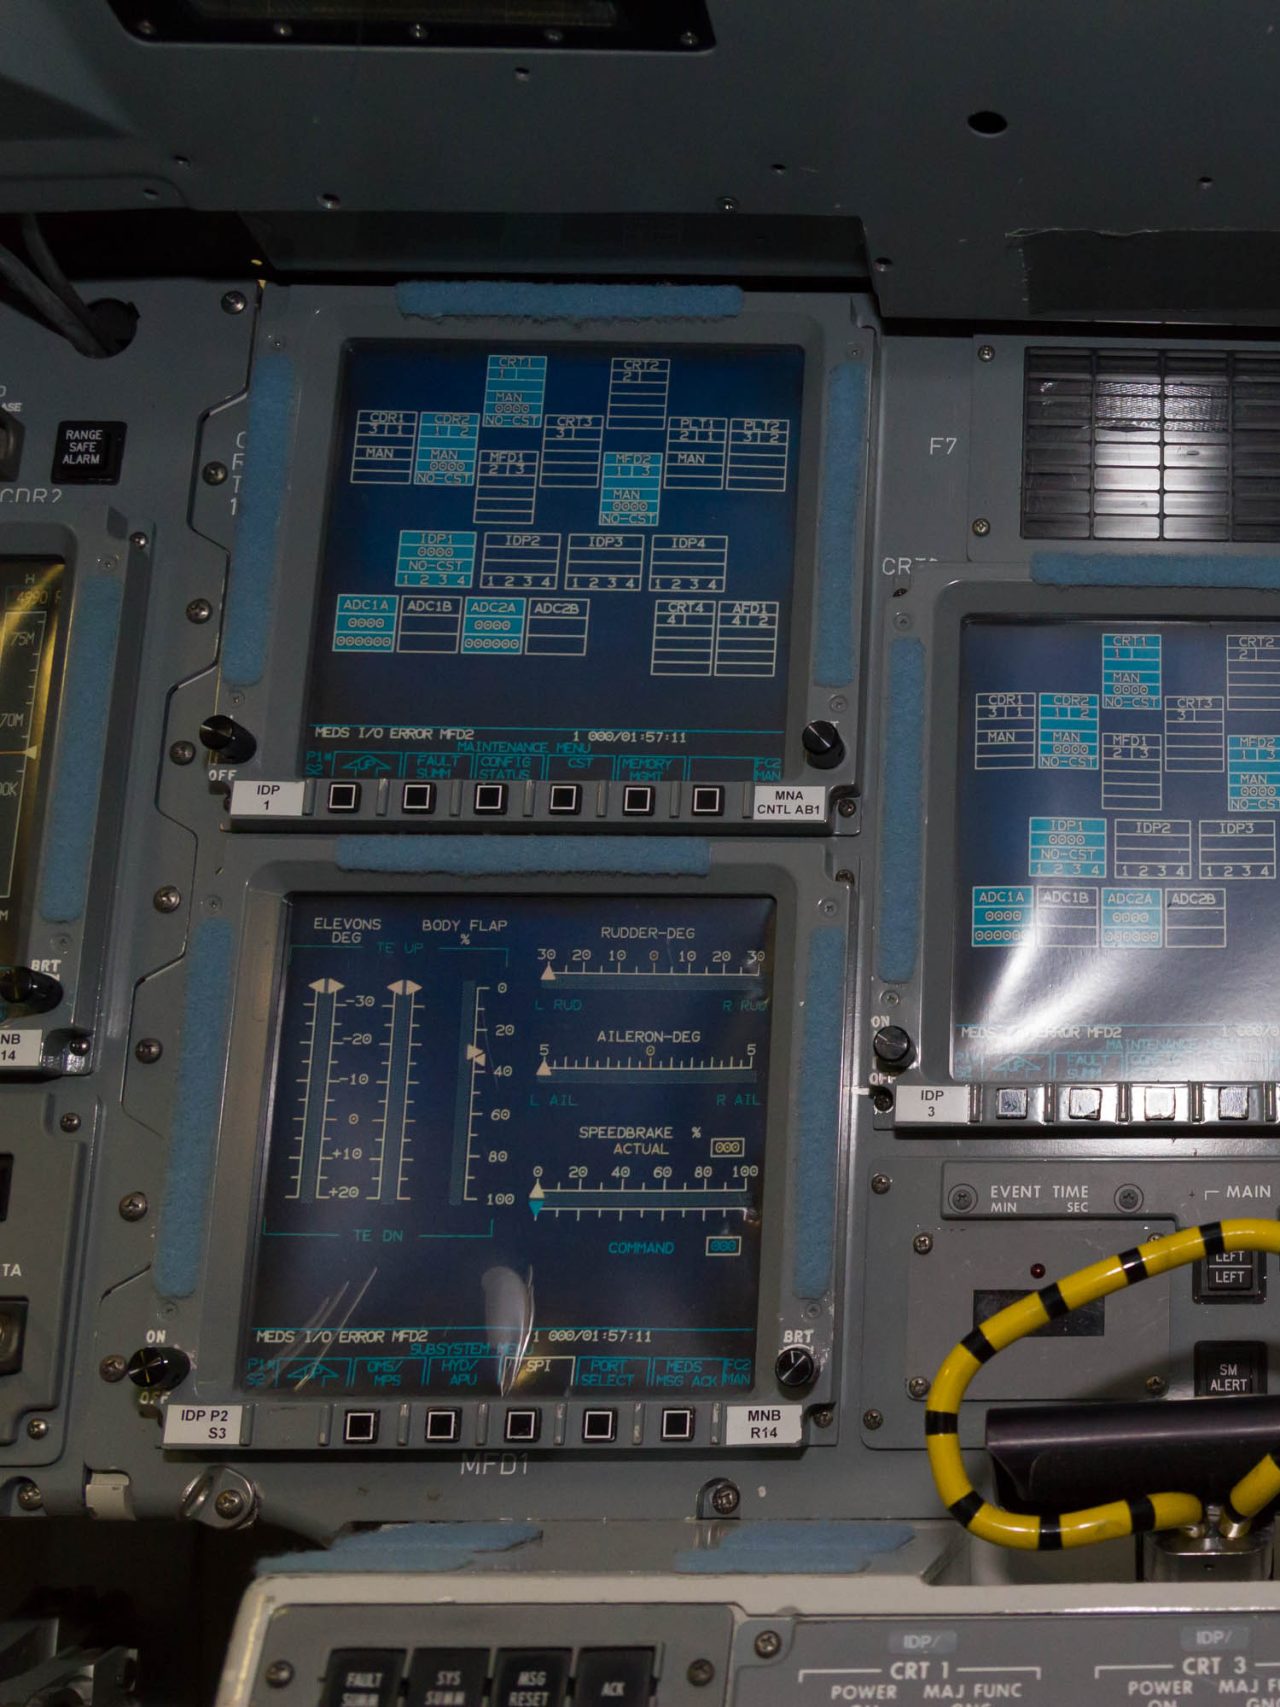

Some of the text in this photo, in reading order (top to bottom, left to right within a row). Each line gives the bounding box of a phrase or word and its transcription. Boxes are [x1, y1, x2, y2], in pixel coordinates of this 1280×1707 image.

[624, 360, 659, 370] CRT2
[370, 412, 403, 422] CDR1
[681, 419, 714, 429] PLT1
[66, 430, 103, 440] RANGE
[69, 442, 97, 453] SAFE
[929, 437, 957, 455] F7
[62, 454, 100, 464] ALARM
[505, 535, 541, 546] IDP2
[588, 536, 623, 547] IDP3
[344, 600, 388, 611] ADC1A
[407, 601, 452, 612] ADC1B
[1239, 637, 1274, 647] CRT2
[315, 726, 475, 740] MEDS I/O ERROR MFD2
[588, 731, 687, 743] 000/01:57:11
[457, 741, 592, 754] MAINTENANCE MENU
[417, 755, 458, 768] FAULT
[622, 759, 671, 770] MEMORY
[208, 769, 238, 781] OFF
[257, 785, 280, 796] IDP
[775, 790, 804, 801] MNA
[264, 801, 270, 811] 1
[757, 804, 820, 815] CNTL AB1
[313, 917, 382, 930] ELEVONS
[422, 919, 508, 932] BODY FLAP
[331, 932, 362, 944] DEG
[601, 927, 696, 939] RUDDER-DEG
[31, 959, 62, 973] BRT
[872, 1015, 890, 1027] ON
[597, 1030, 701, 1043] AILERON-DEG
[921, 1090, 944, 1101] IDP
[927, 1106, 936, 1117] 3
[579, 1126, 673, 1139] SPEEDBRAKE
[613, 1143, 669, 1155] ACTUAL
[990, 1185, 1089, 1198] EVENT TIME
[1226, 1185, 1272, 1198] MAIN
[990, 1202, 1089, 1213] MIN SEC
[607, 1242, 676, 1255] COMMAND
[1215, 1250, 1245, 1262] LEFT
[1215, 1271, 1245, 1283] LEFT
[146, 1330, 167, 1343] ON
[257, 1330, 429, 1343] MEDS I/O ERROR MFD2
[783, 1329, 814, 1343] BRT
[590, 1360, 626, 1372] PORT
[1219, 1363, 1238, 1376] SM
[581, 1374, 634, 1387] SELECT
[1210, 1379, 1248, 1391] ALERT
[181, 1409, 228, 1421] IDP P2
[747, 1409, 781, 1421] MNB
[208, 1426, 227, 1439] S3
[751, 1427, 778, 1439] R14
[461, 1453, 529, 1475] MFD1
[890, 1661, 949, 1680] CRT 1
[1182, 1656, 1247, 1675] CRT 3
[346, 1672, 383, 1688] FAULT
[436, 1670, 462, 1685] SYS
[517, 1670, 546, 1686] MSG
[601, 1681, 625, 1697] ACK
[831, 1682, 1022, 1700] POWER MAJ FUNC
[1128, 1680, 1193, 1695] POWER
[1218, 1679, 1259, 1694] MAJ
[508, 1691, 550, 1707] RESET
